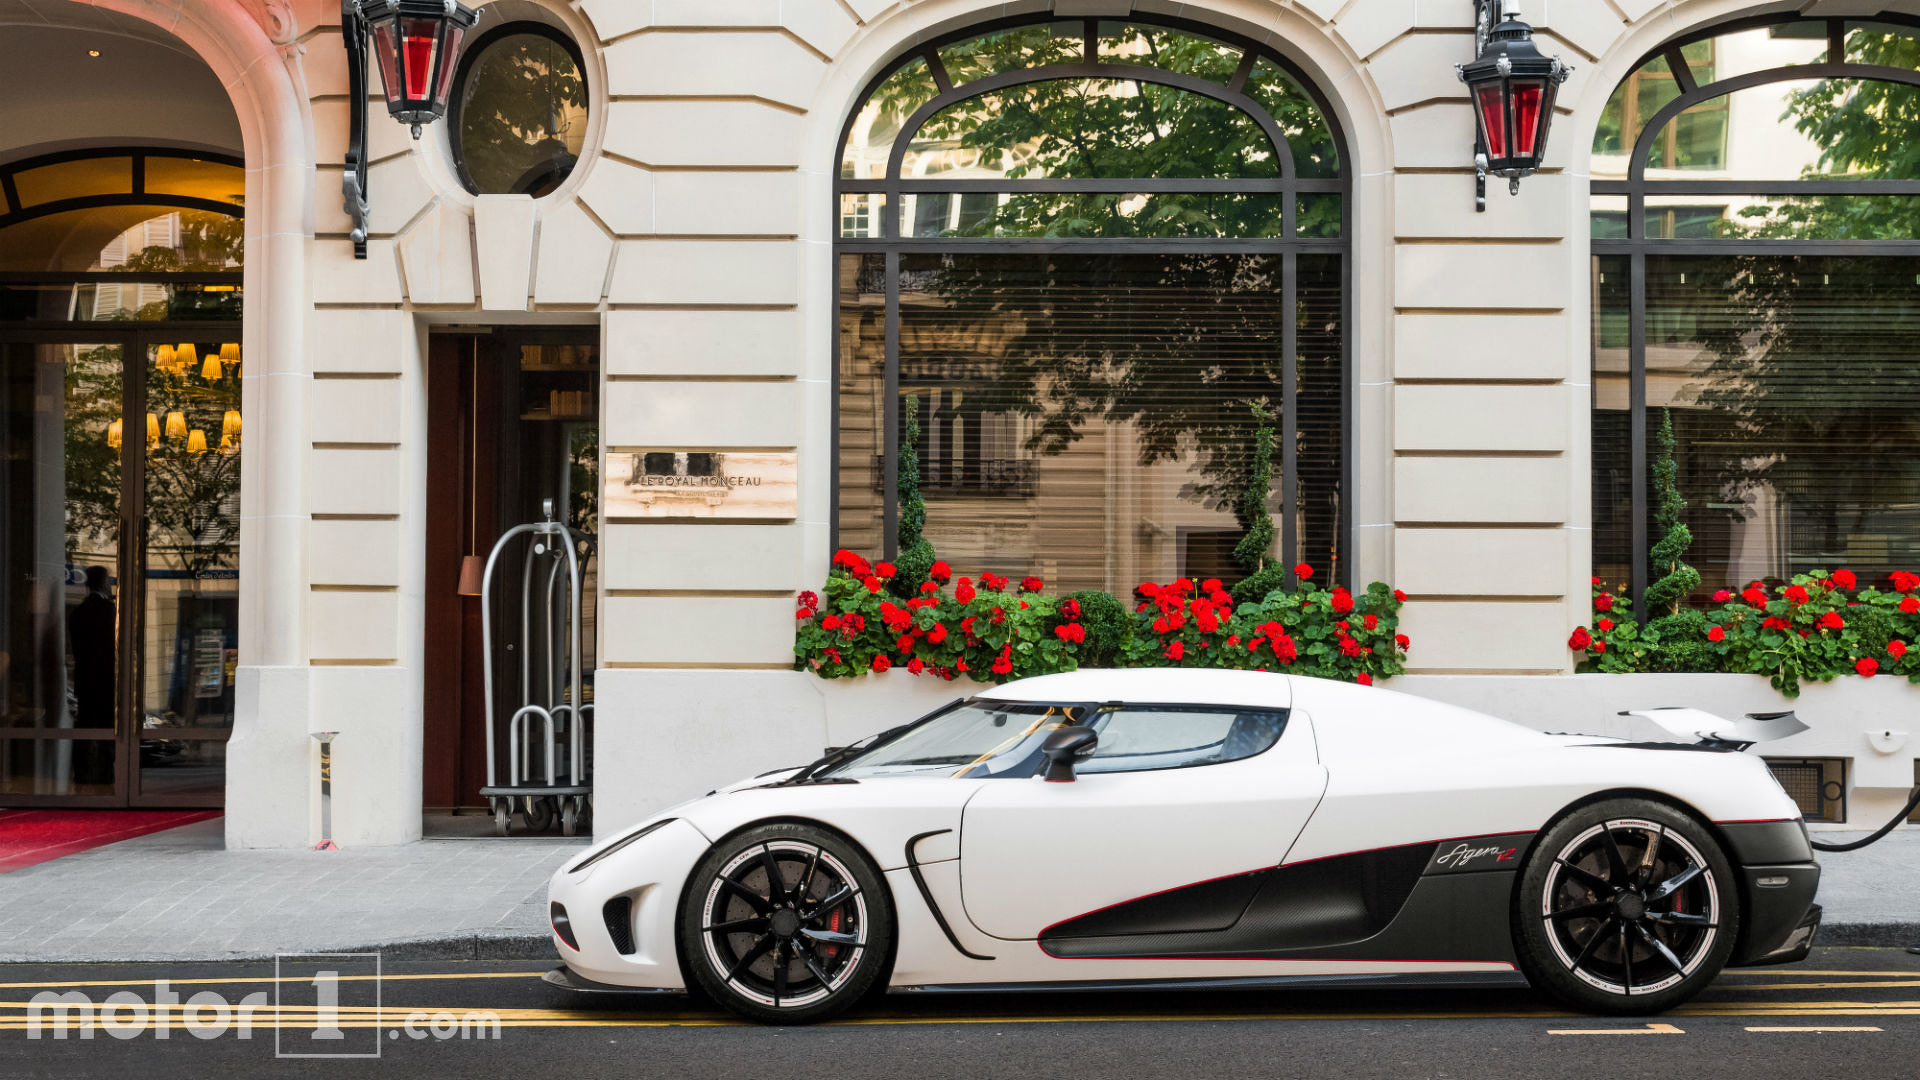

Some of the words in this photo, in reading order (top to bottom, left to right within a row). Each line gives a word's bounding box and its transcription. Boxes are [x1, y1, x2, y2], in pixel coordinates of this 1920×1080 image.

[641, 476, 653, 486] LE
[700, 476, 761, 487] MONCEAU
[1437, 843, 1505, 869] Agera
